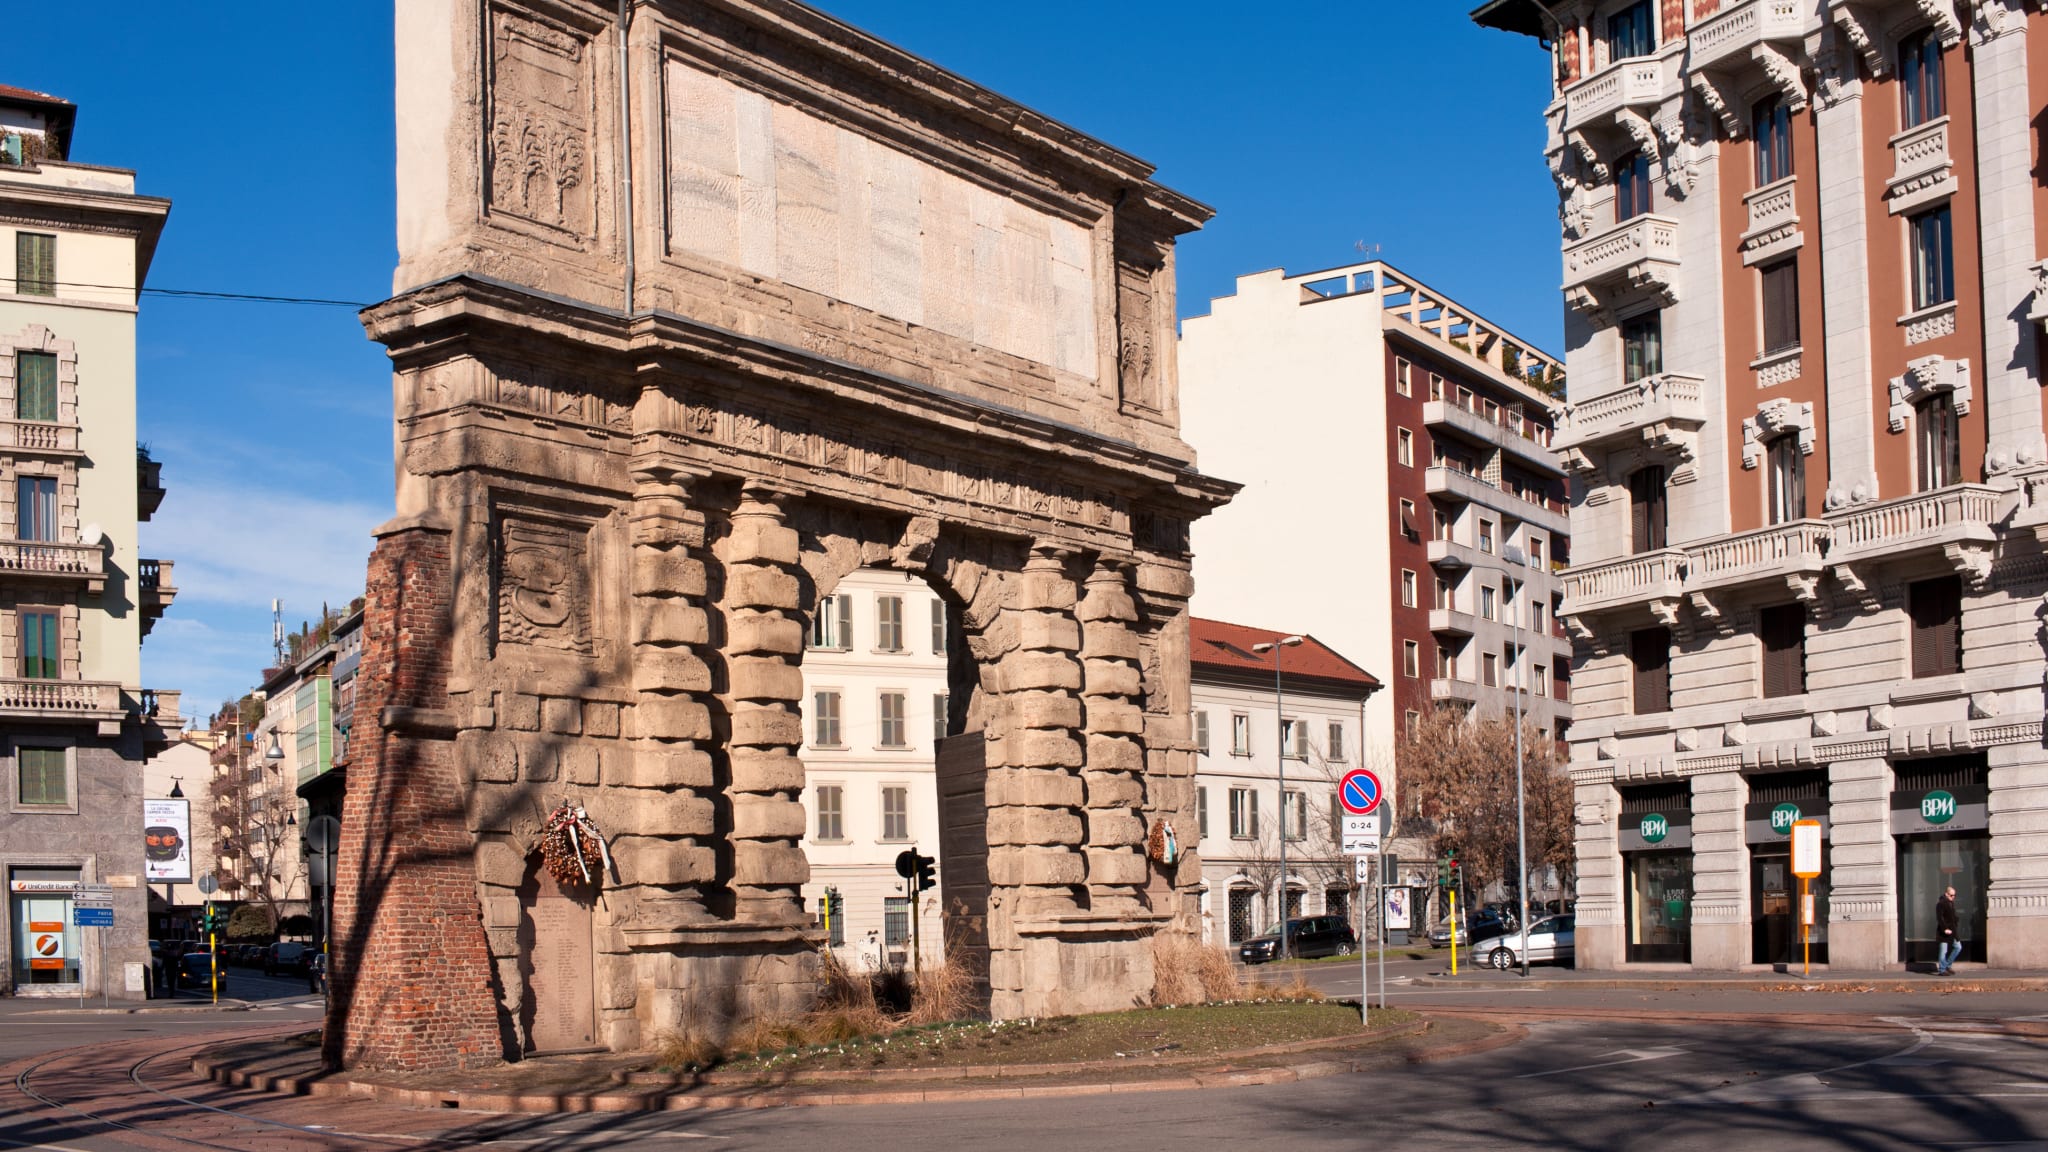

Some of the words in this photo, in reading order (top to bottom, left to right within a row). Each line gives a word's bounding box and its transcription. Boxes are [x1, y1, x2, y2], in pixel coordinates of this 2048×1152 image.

[1922, 796, 1954, 817] BPM
[1641, 819, 1666, 837] BPM
[1772, 808, 1800, 828] BPM
